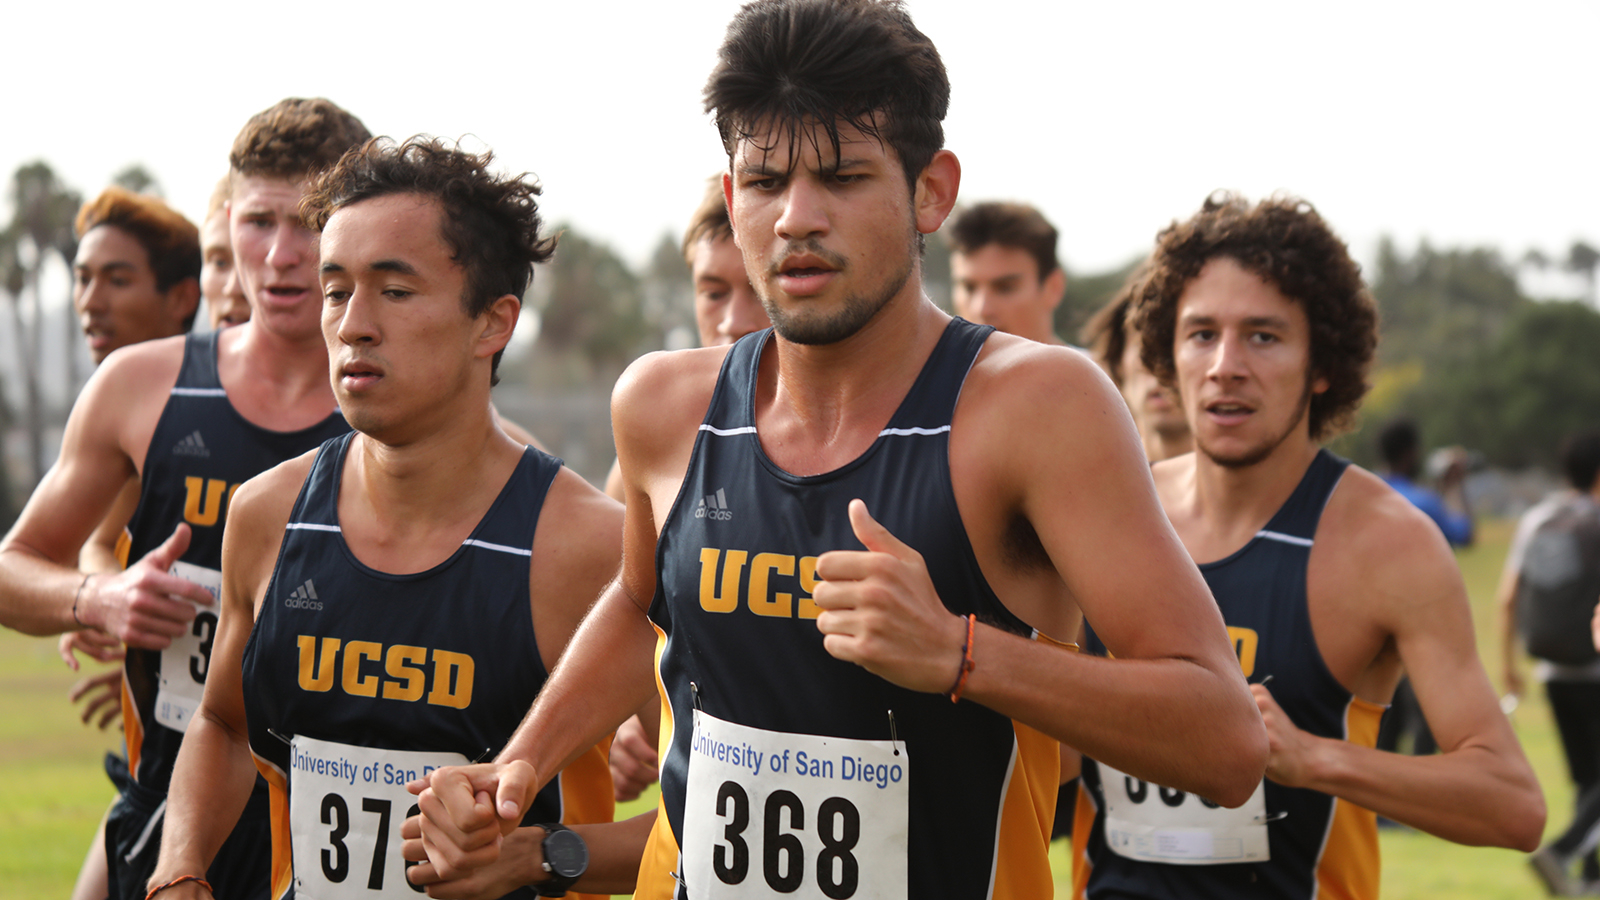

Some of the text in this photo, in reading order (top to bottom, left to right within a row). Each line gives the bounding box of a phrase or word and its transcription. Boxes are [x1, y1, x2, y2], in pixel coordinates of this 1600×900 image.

[695, 506, 732, 521] adidas
[285, 597, 323, 611] adidas
[297, 635, 475, 710] UCSD
[292, 744, 358, 785] University
[363, 762, 379, 784] of
[383, 763, 417, 786] San
[692, 726, 903, 789] University of San Diego
[713, 780, 860, 900] 368
